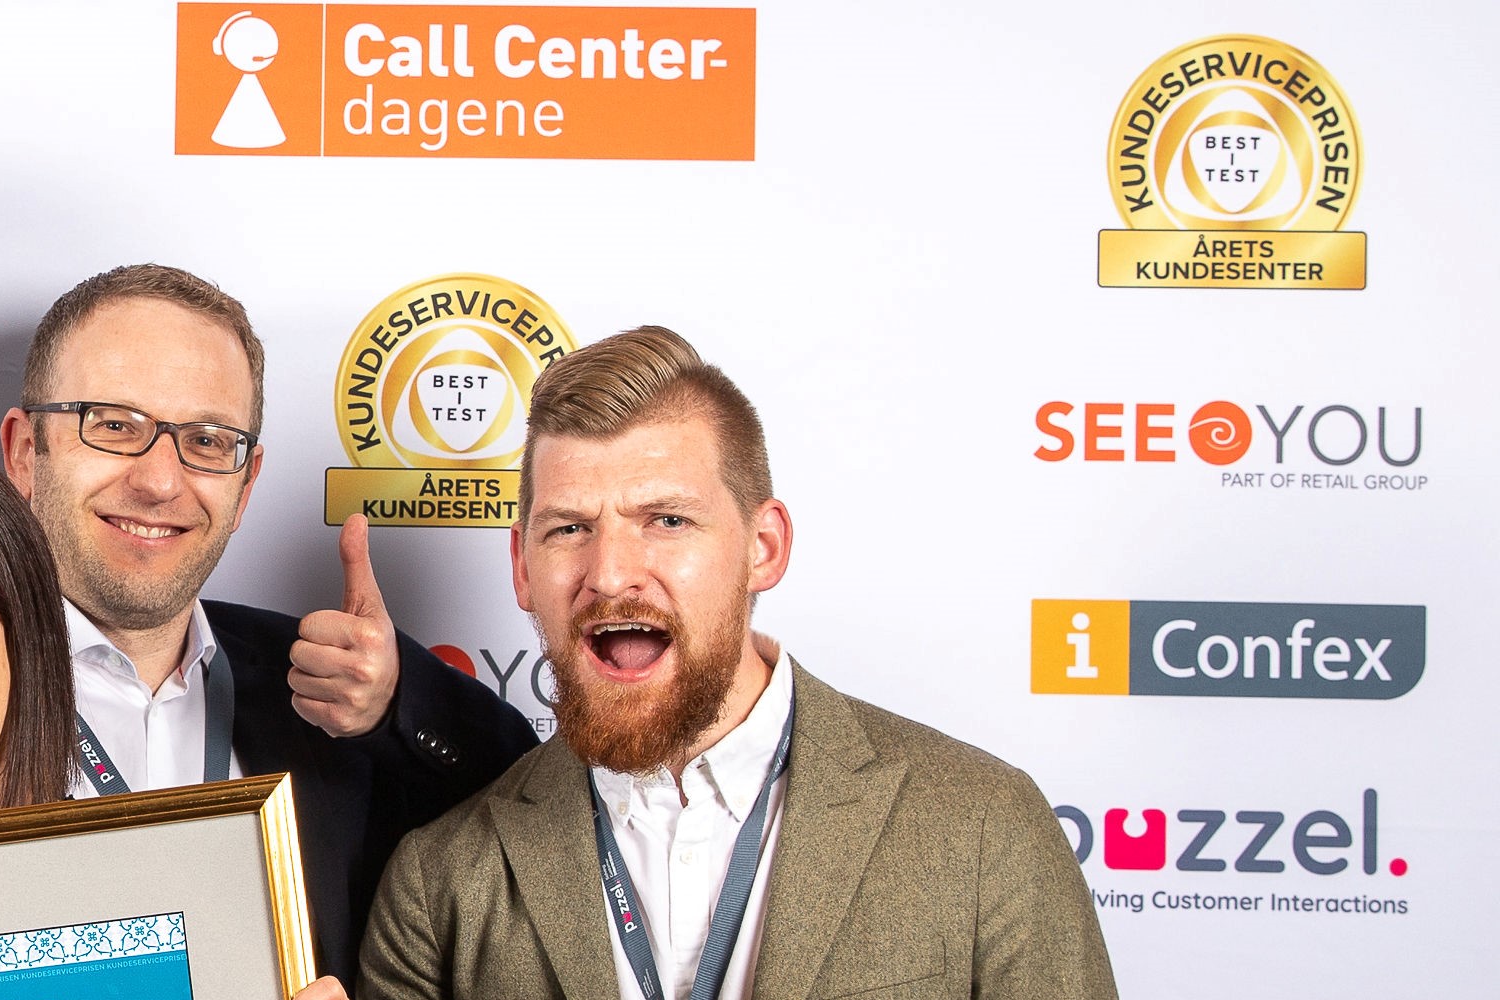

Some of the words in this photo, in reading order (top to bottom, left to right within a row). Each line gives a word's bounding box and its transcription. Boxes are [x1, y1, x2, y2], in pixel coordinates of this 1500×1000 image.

[342, 23, 474, 79] Call
[494, 26, 727, 81] Center-
[342, 86, 565, 150] dagene
[1120, 51, 1350, 214] KUNDESERVICEPRISEN
[1205, 136, 1260, 150] BEST
[1205, 169, 1259, 184] TEST
[1192, 234, 1274, 260] ÅRETS
[1135, 261, 1324, 282] KUNDESENTER
[433, 375, 488, 389] BEST
[432, 407, 487, 422] TEST
[1033, 401, 1177, 462] SEE
[1256, 403, 1423, 467] YOU
[419, 472, 500, 497] ÅRETS
[1221, 472, 1265, 488] PART
[1270, 473, 1296, 489] OF
[1302, 473, 1358, 489] RETAIL
[1363, 474, 1428, 490] GROUP
[1152, 619, 1393, 681] Confex
[1152, 891, 1263, 911] Customer
[1270, 893, 1409, 915] Interactions
[21, 964, 105, 980] KUNDESERVICEPRISEN
